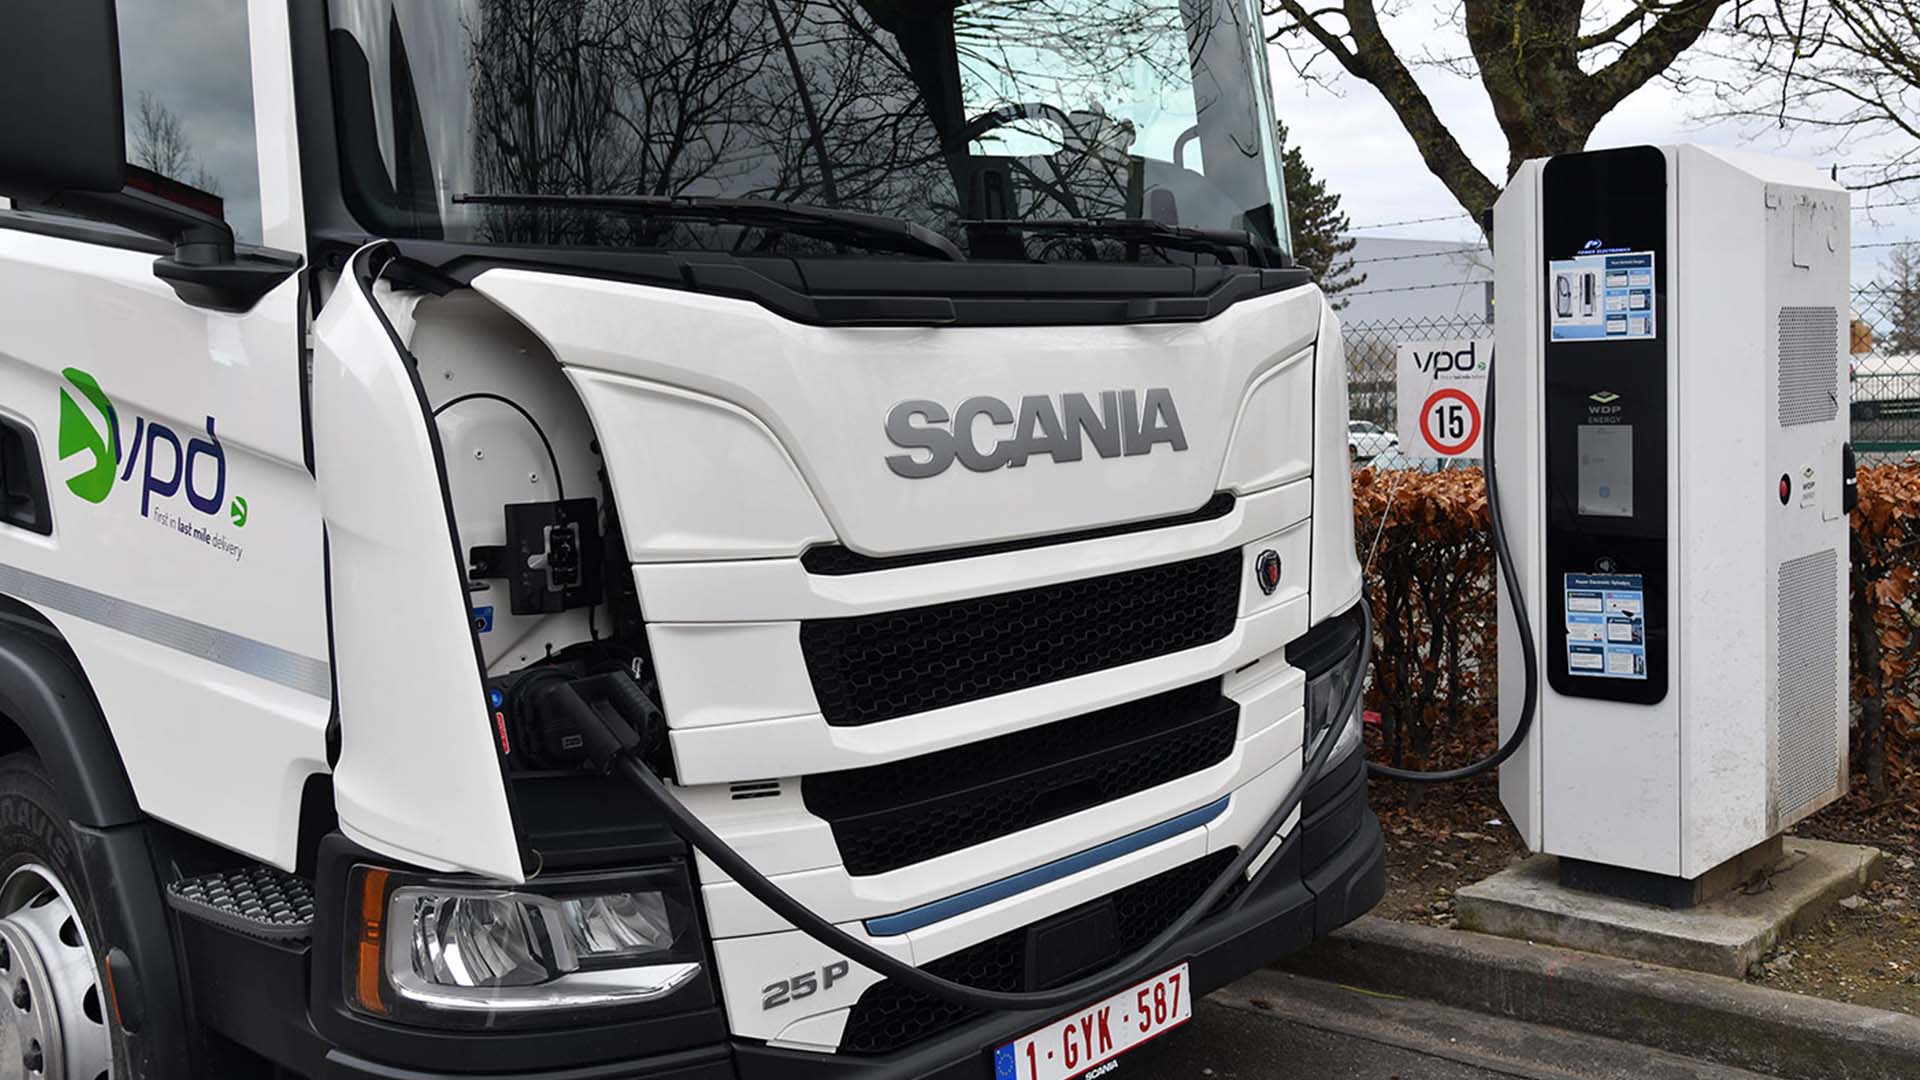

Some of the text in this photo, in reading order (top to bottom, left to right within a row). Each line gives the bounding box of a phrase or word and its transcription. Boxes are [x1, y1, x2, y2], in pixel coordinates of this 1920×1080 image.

[1413, 341, 1475, 380] vpd
[1434, 405, 1464, 439] 15
[1588, 405, 1622, 414] WDP
[1588, 415, 1622, 424] ENERGY
[884, 387, 1189, 479] SCANIA
[107, 404, 227, 518] vpd
[153, 506, 243, 562] first in last mile delivery
[761, 959, 850, 1011] 25 P
[1085, 1059, 1119, 1080] SCANIA
